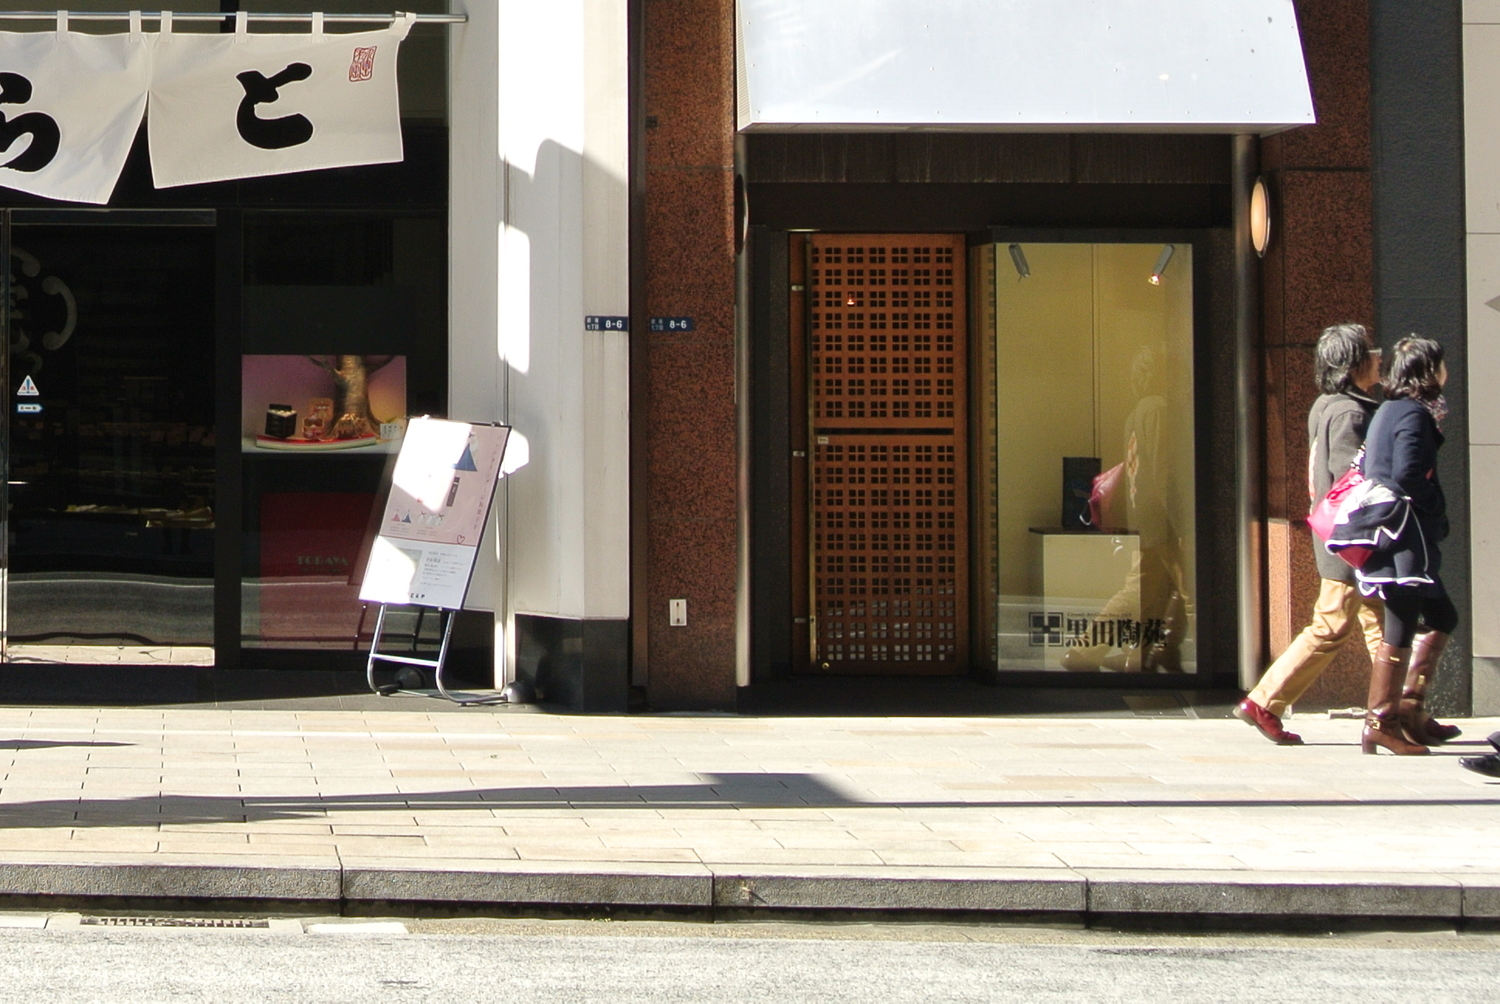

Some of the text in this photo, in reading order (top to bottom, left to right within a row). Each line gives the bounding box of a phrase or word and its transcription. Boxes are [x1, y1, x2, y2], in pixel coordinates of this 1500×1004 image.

[605, 320, 623, 329] 8-6
[669, 320, 687, 329] 8-6
[1065, 617, 1168, 648] 黒田陶苑
